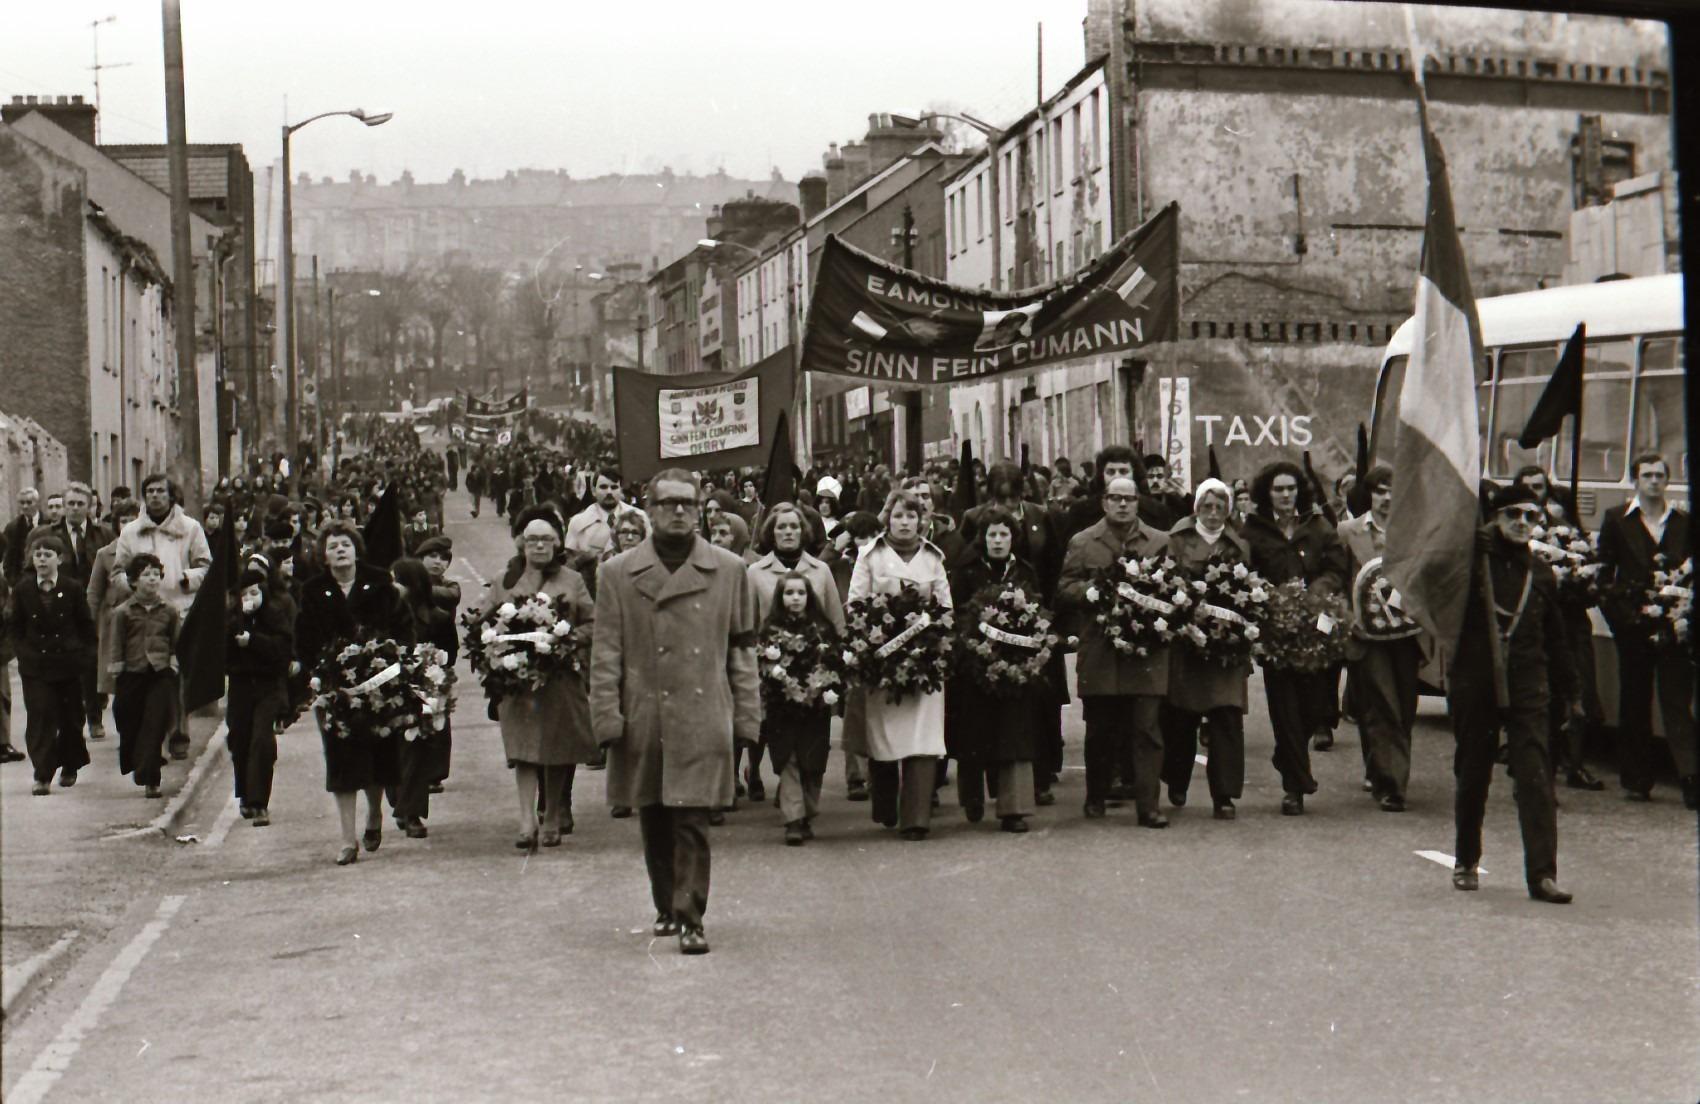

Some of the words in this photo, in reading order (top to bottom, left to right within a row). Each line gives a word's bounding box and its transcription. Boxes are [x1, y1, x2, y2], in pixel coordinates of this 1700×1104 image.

[845, 348, 920, 381] SINN
[932, 353, 999, 381] FEIN
[1012, 318, 1144, 365] CUMANN
[670, 432, 689, 445] SINN
[690, 430, 707, 442] FEIN
[709, 423, 748, 438] CUMANN
[1195, 415, 1313, 447] TAXIS
[690, 438, 726, 455] DERRY
